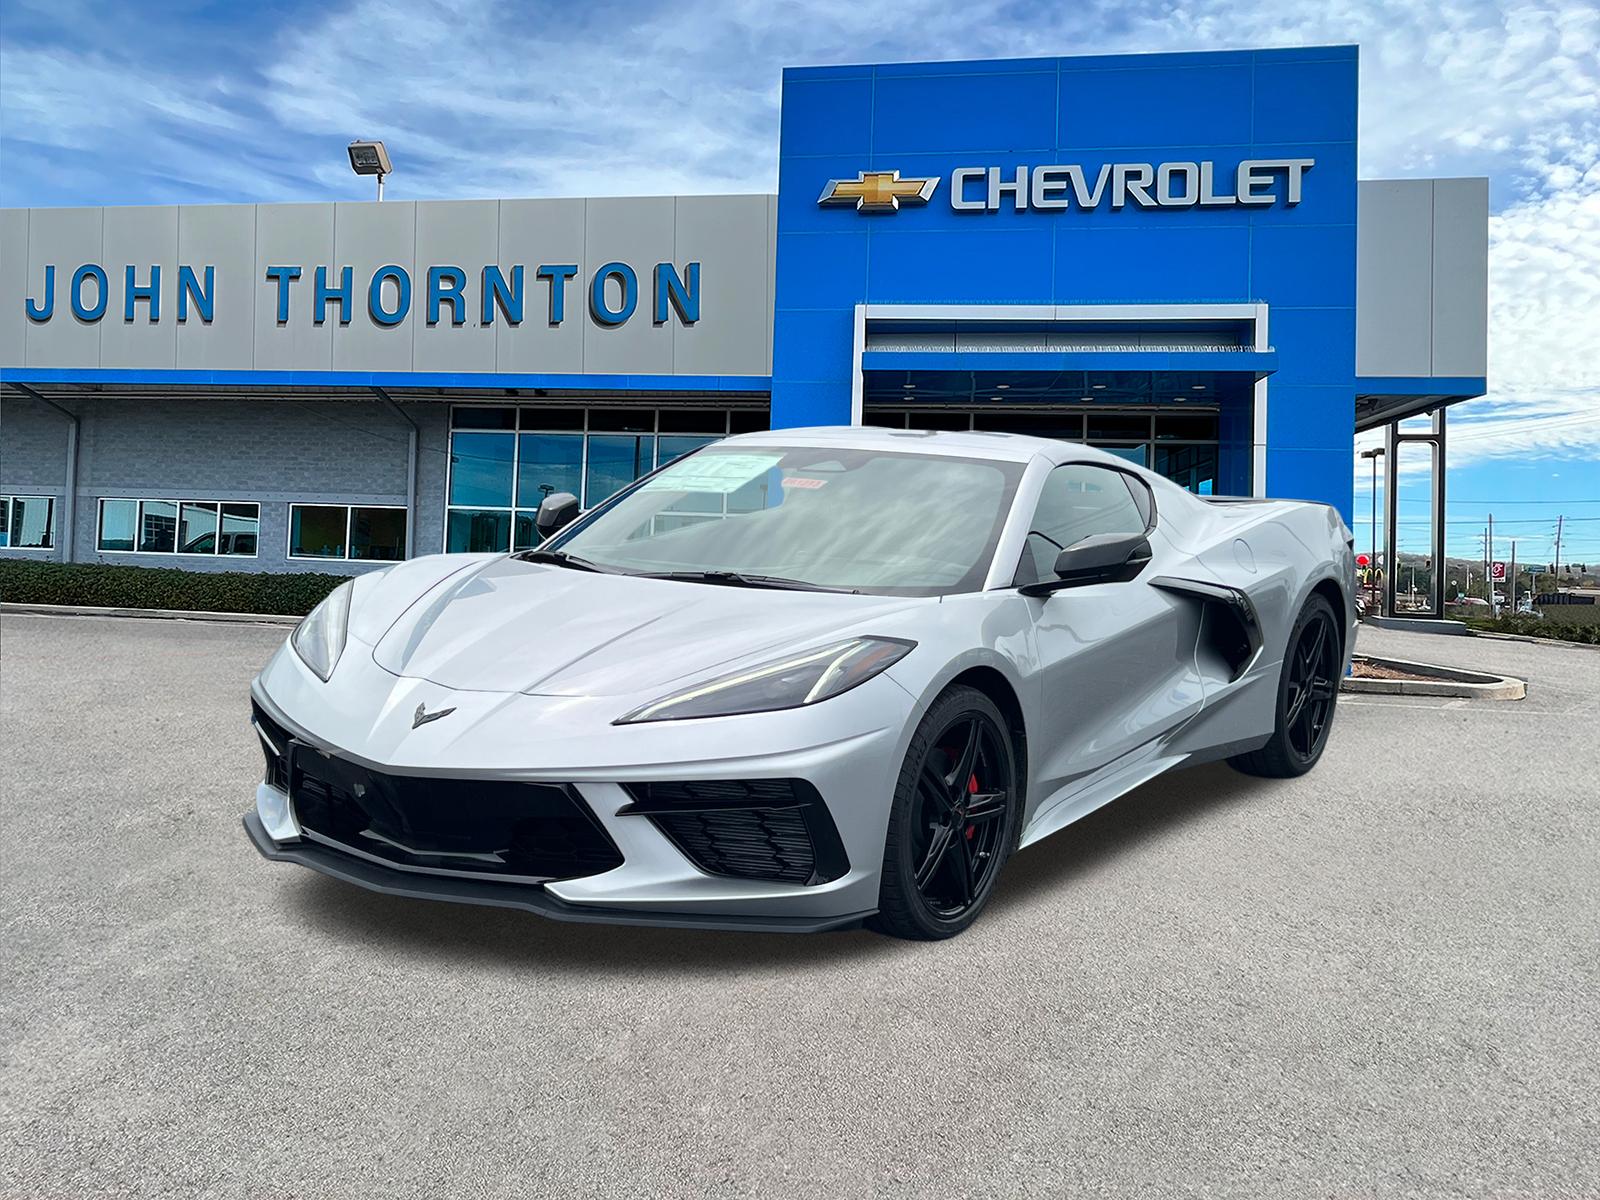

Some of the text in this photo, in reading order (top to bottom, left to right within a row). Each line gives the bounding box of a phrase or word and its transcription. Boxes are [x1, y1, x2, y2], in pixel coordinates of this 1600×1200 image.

[950, 158, 1315, 213] CHEVROLET
[25, 261, 702, 327] JOHN THORNTON
